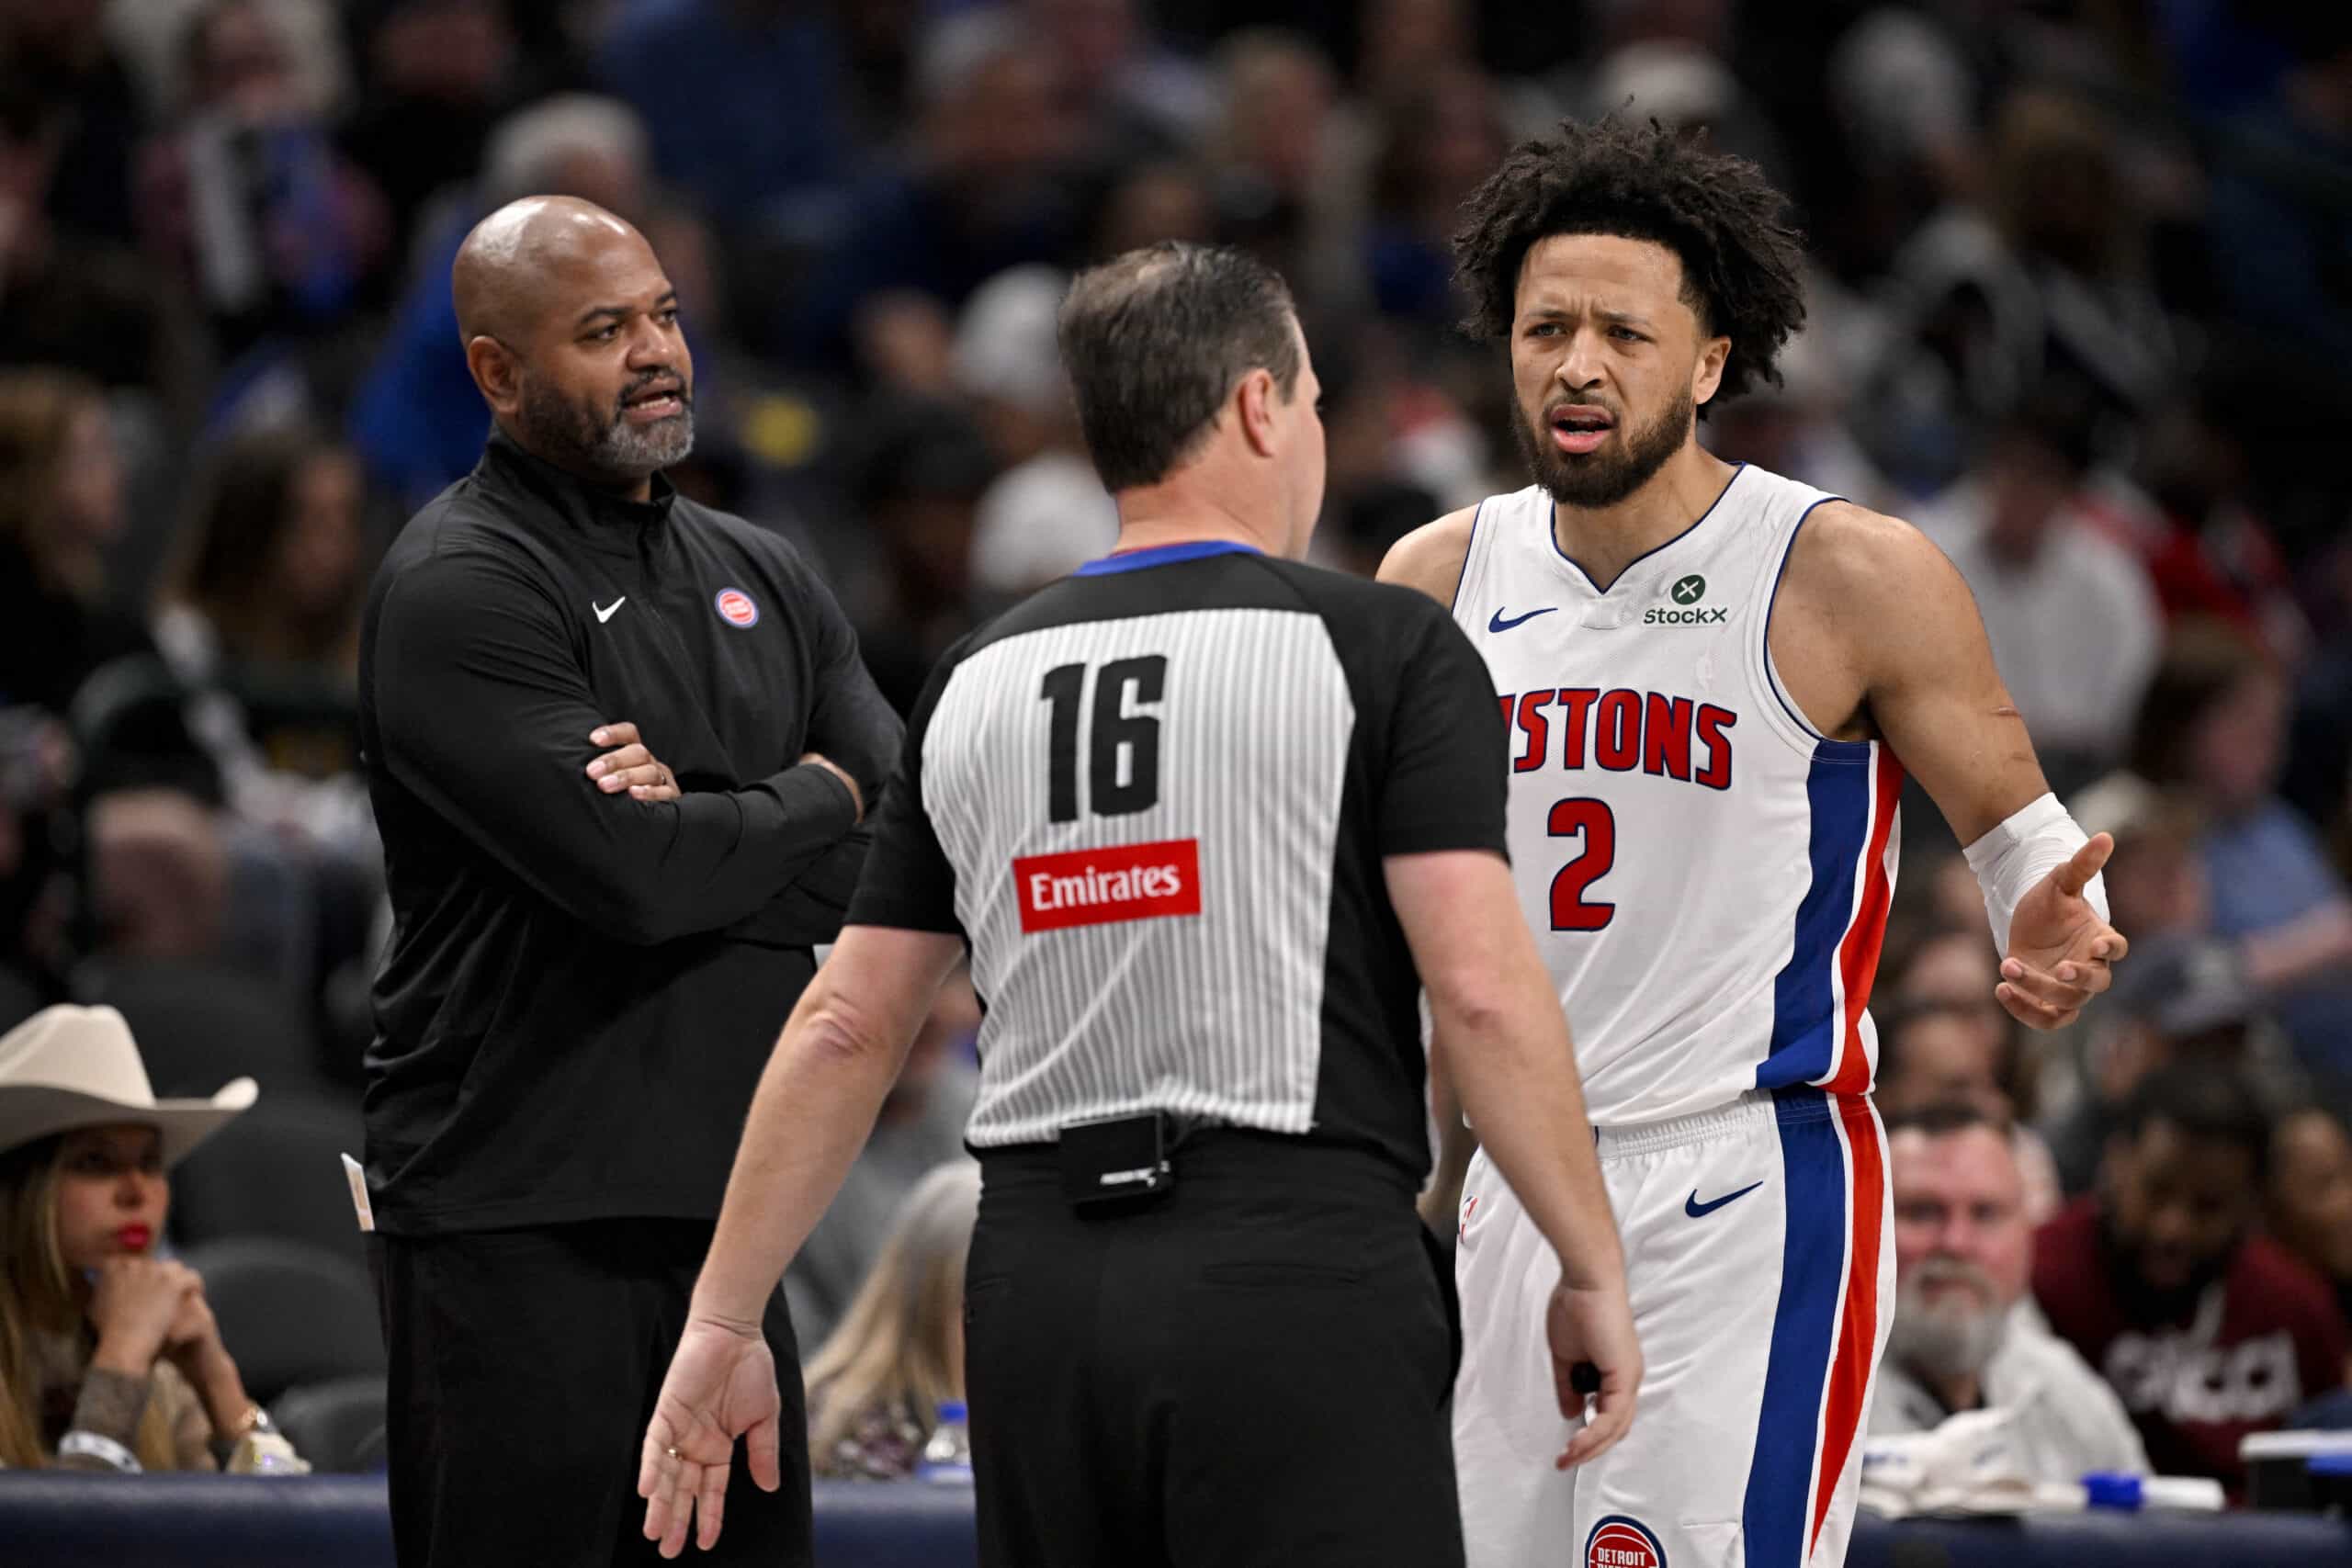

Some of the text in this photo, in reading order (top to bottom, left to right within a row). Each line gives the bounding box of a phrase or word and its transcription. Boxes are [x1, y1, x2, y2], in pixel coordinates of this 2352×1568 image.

[1645, 607, 1727, 625] stockX
[1041, 655, 1167, 823] 16
[1498, 688, 1737, 791] STONS
[1030, 864, 1182, 911] Emirates
[1547, 797, 1615, 931] 2
[1597, 1547, 1646, 1567] DETROIT
